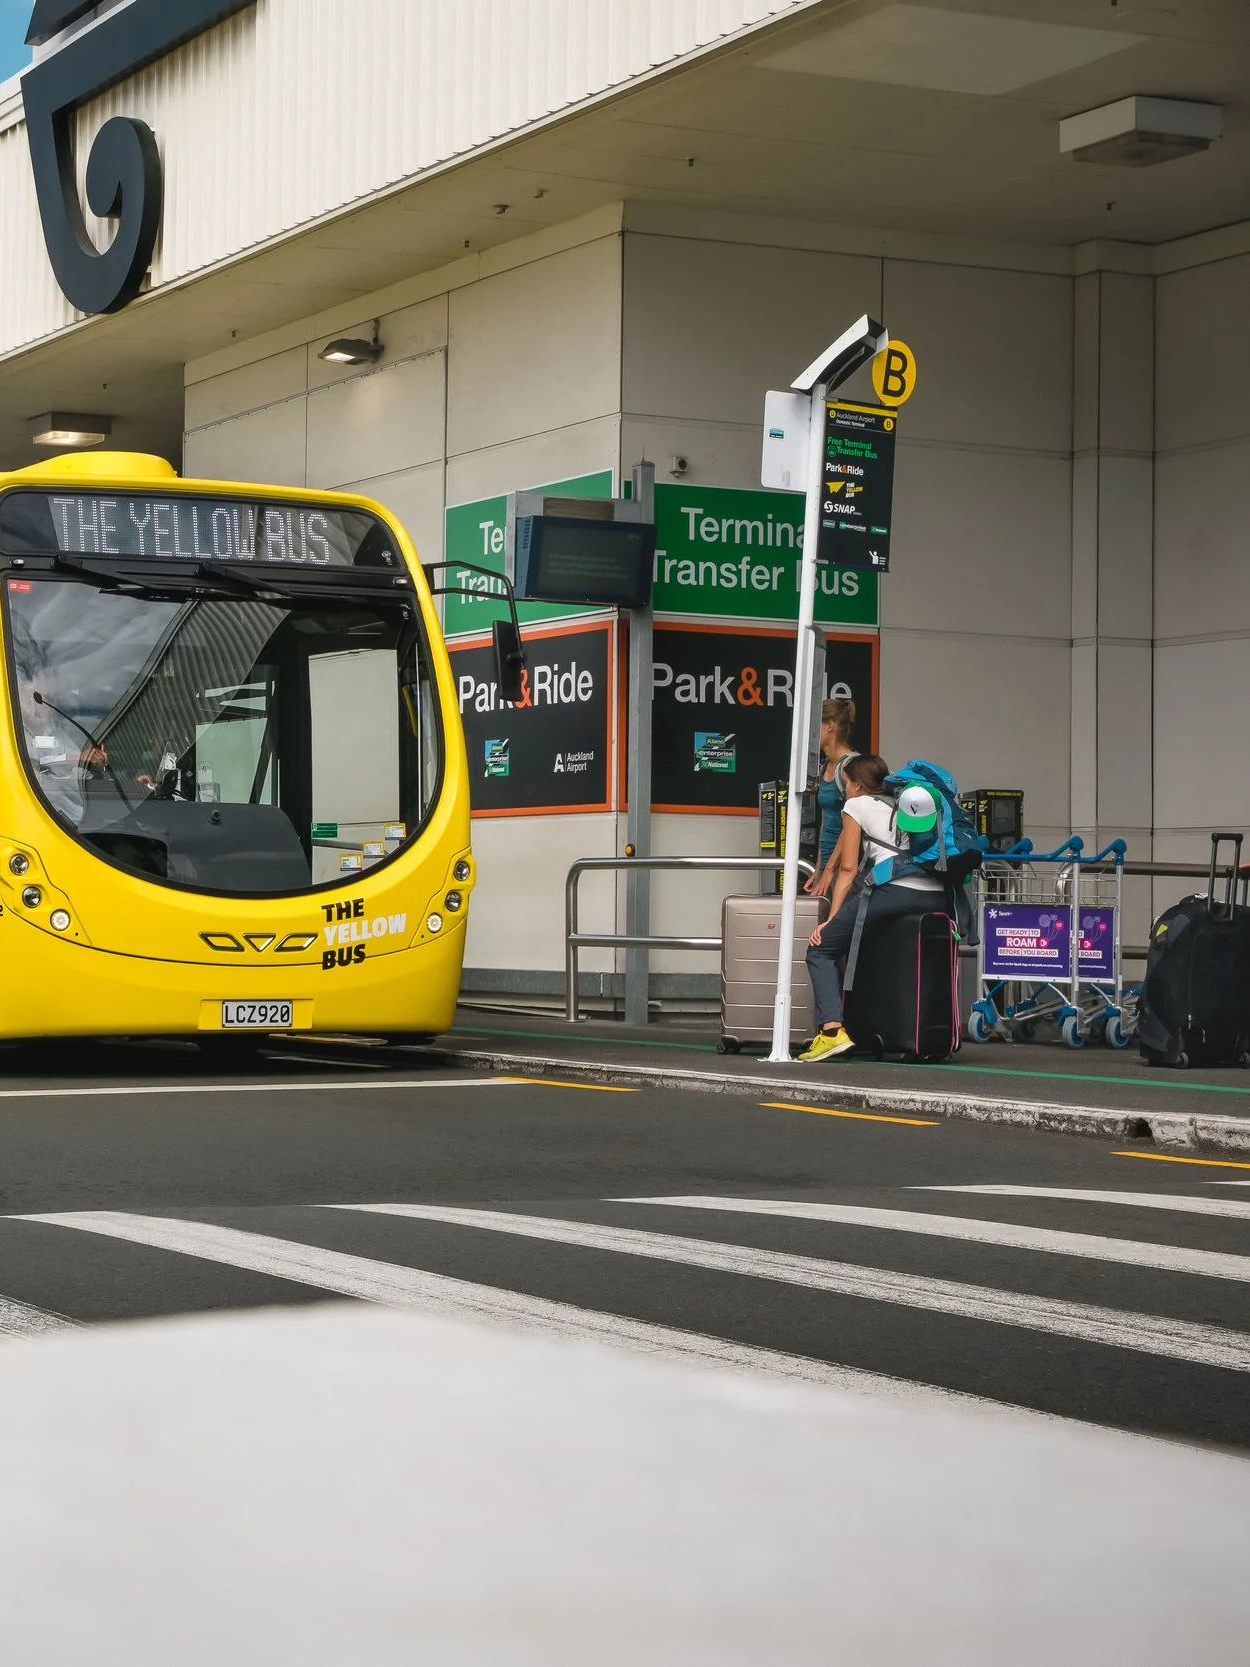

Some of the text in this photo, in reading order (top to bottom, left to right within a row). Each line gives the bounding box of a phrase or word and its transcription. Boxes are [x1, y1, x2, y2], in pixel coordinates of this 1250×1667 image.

[881, 348, 908, 398] B
[837, 411, 858, 420] Auckland
[828, 436, 872, 450] Free Terminal
[837, 446, 878, 459] Transfer Bus
[826, 462, 864, 476] Park&Ride
[833, 503, 855, 515] SNAP
[53, 498, 330, 565] THE YELLOW BUS
[680, 507, 805, 549] Termin
[653, 550, 785, 591] Transfer
[456, 570, 507, 604] Tran
[459, 662, 593, 714] Par&Ride
[651, 663, 852, 707] Park&Re
[567, 751, 594, 762] Auckland
[567, 763, 587, 774] Airport
[321, 898, 364, 922] THE
[323, 912, 406, 946] YELLOW
[1006, 937, 1037, 947] ROAM
[322, 944, 366, 970] BUS
[225, 1005, 290, 1023] LCZ920
